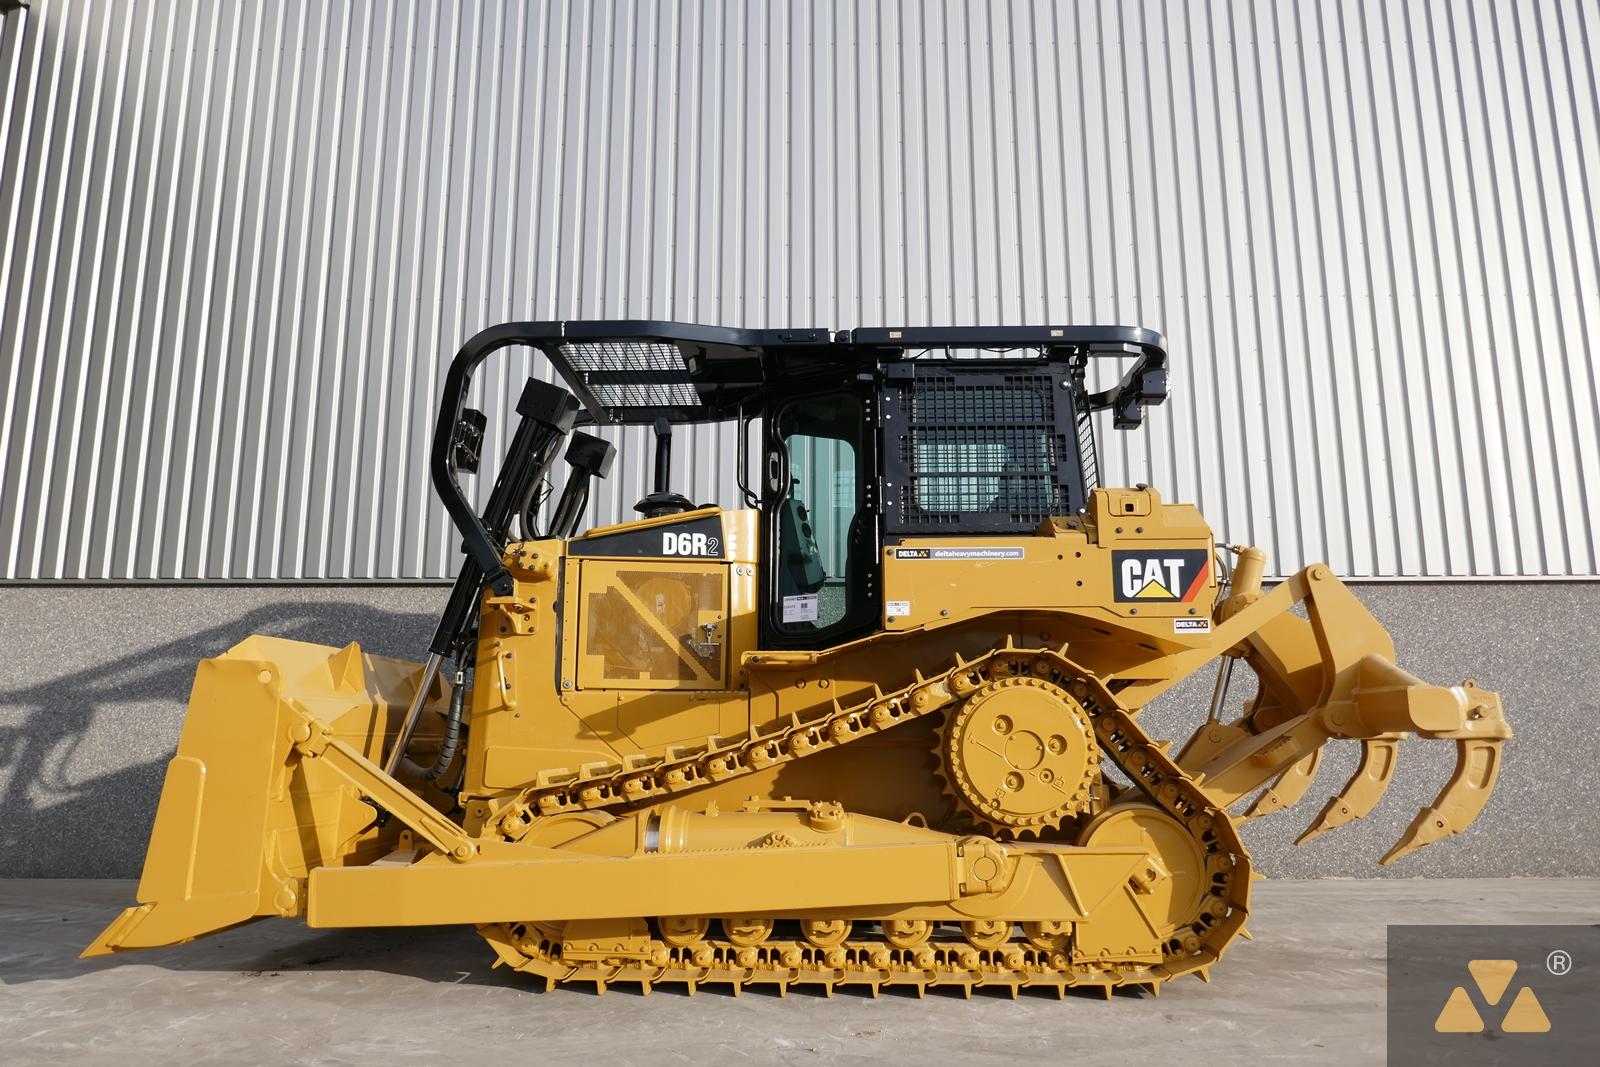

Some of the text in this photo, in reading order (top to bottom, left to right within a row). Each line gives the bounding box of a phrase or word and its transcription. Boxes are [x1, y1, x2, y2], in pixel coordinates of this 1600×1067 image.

[662, 532, 719, 556] D6R2
[935, 550, 1019, 558] deltaheavymachinery.com
[1121, 558, 1185, 598] CAT
